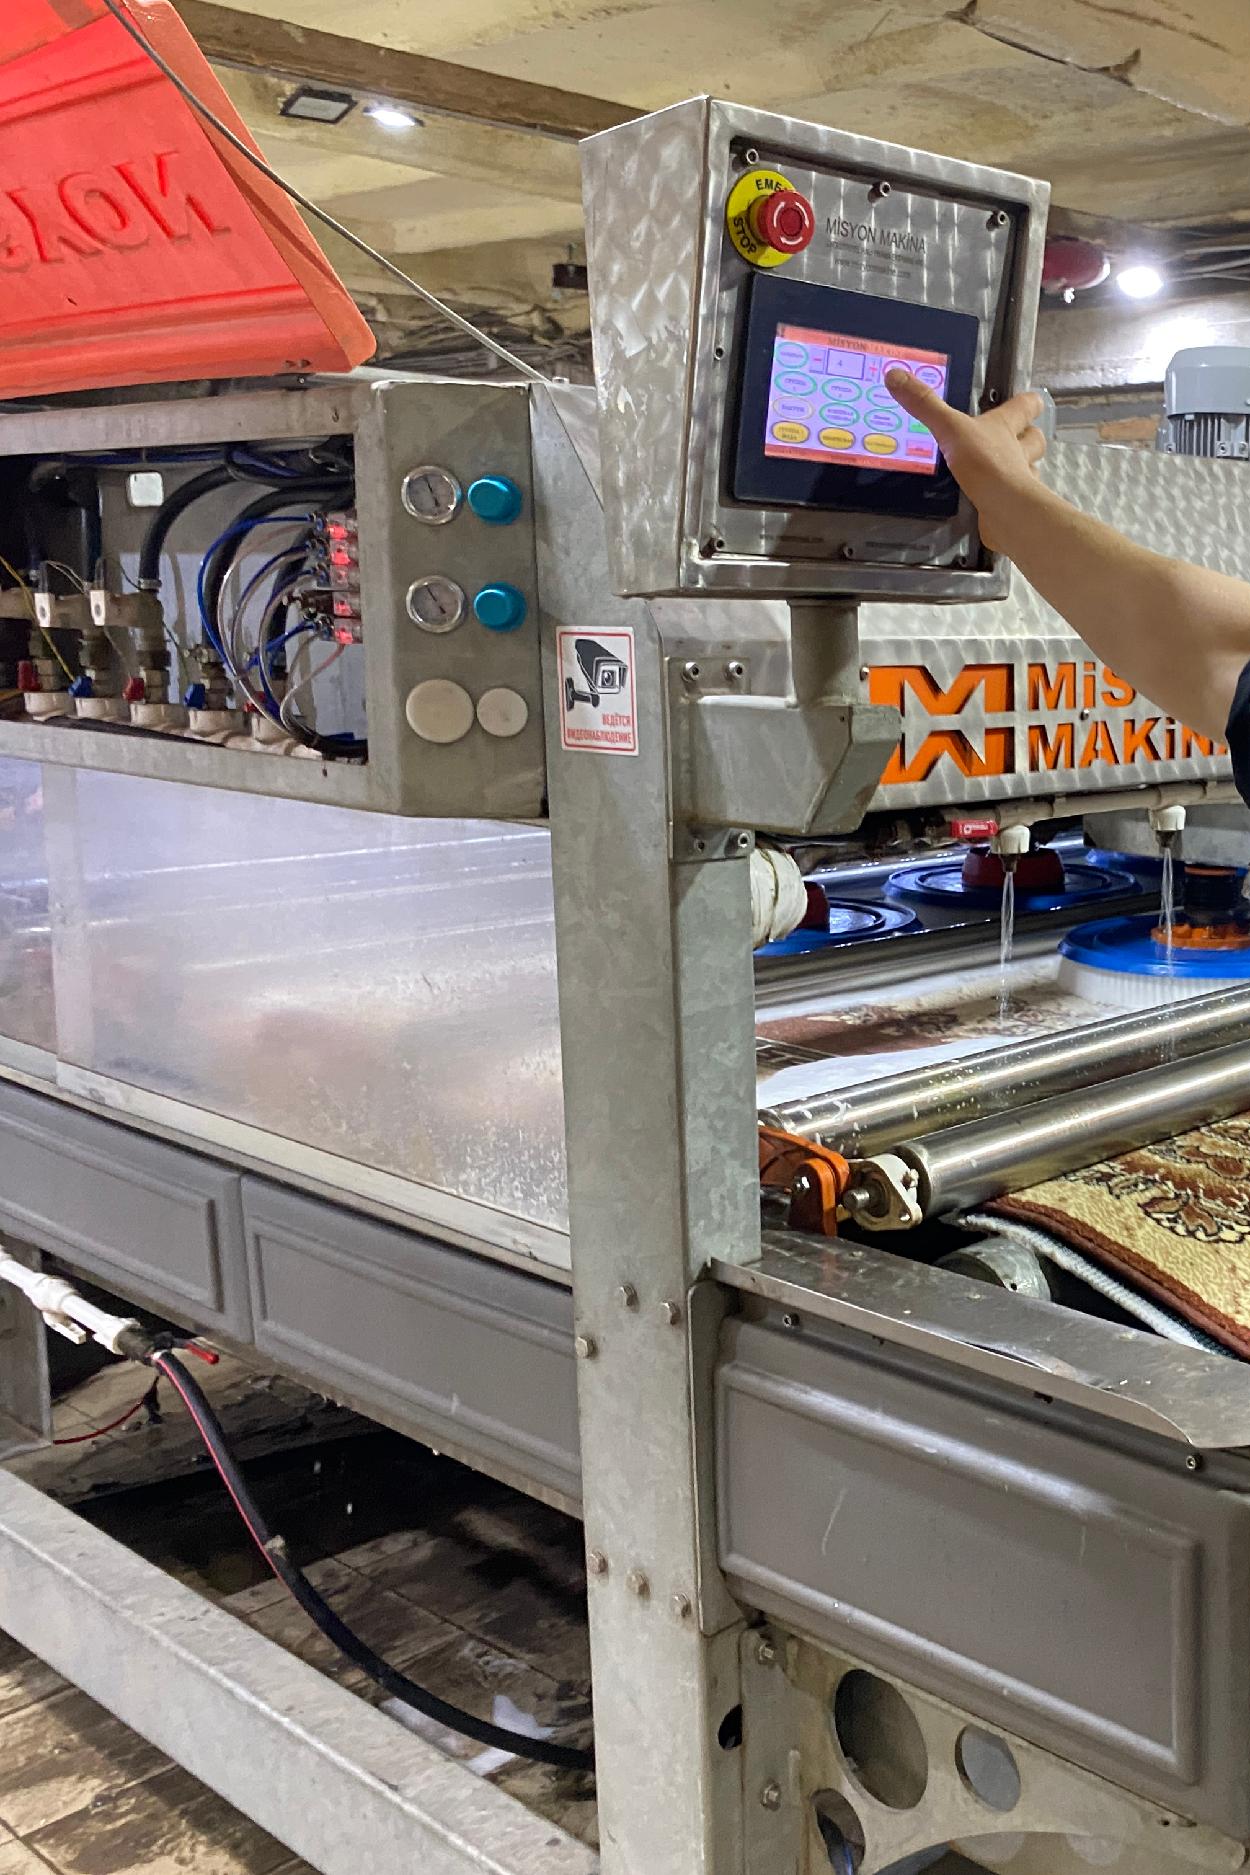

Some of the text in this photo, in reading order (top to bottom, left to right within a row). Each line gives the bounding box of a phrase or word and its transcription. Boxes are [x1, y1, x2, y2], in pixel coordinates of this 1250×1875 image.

[733, 217, 757, 254] STOP
[826, 216, 877, 244] MİSYON
[1028, 662, 1136, 712] MiS
[1028, 716, 1229, 773] MAKiN
